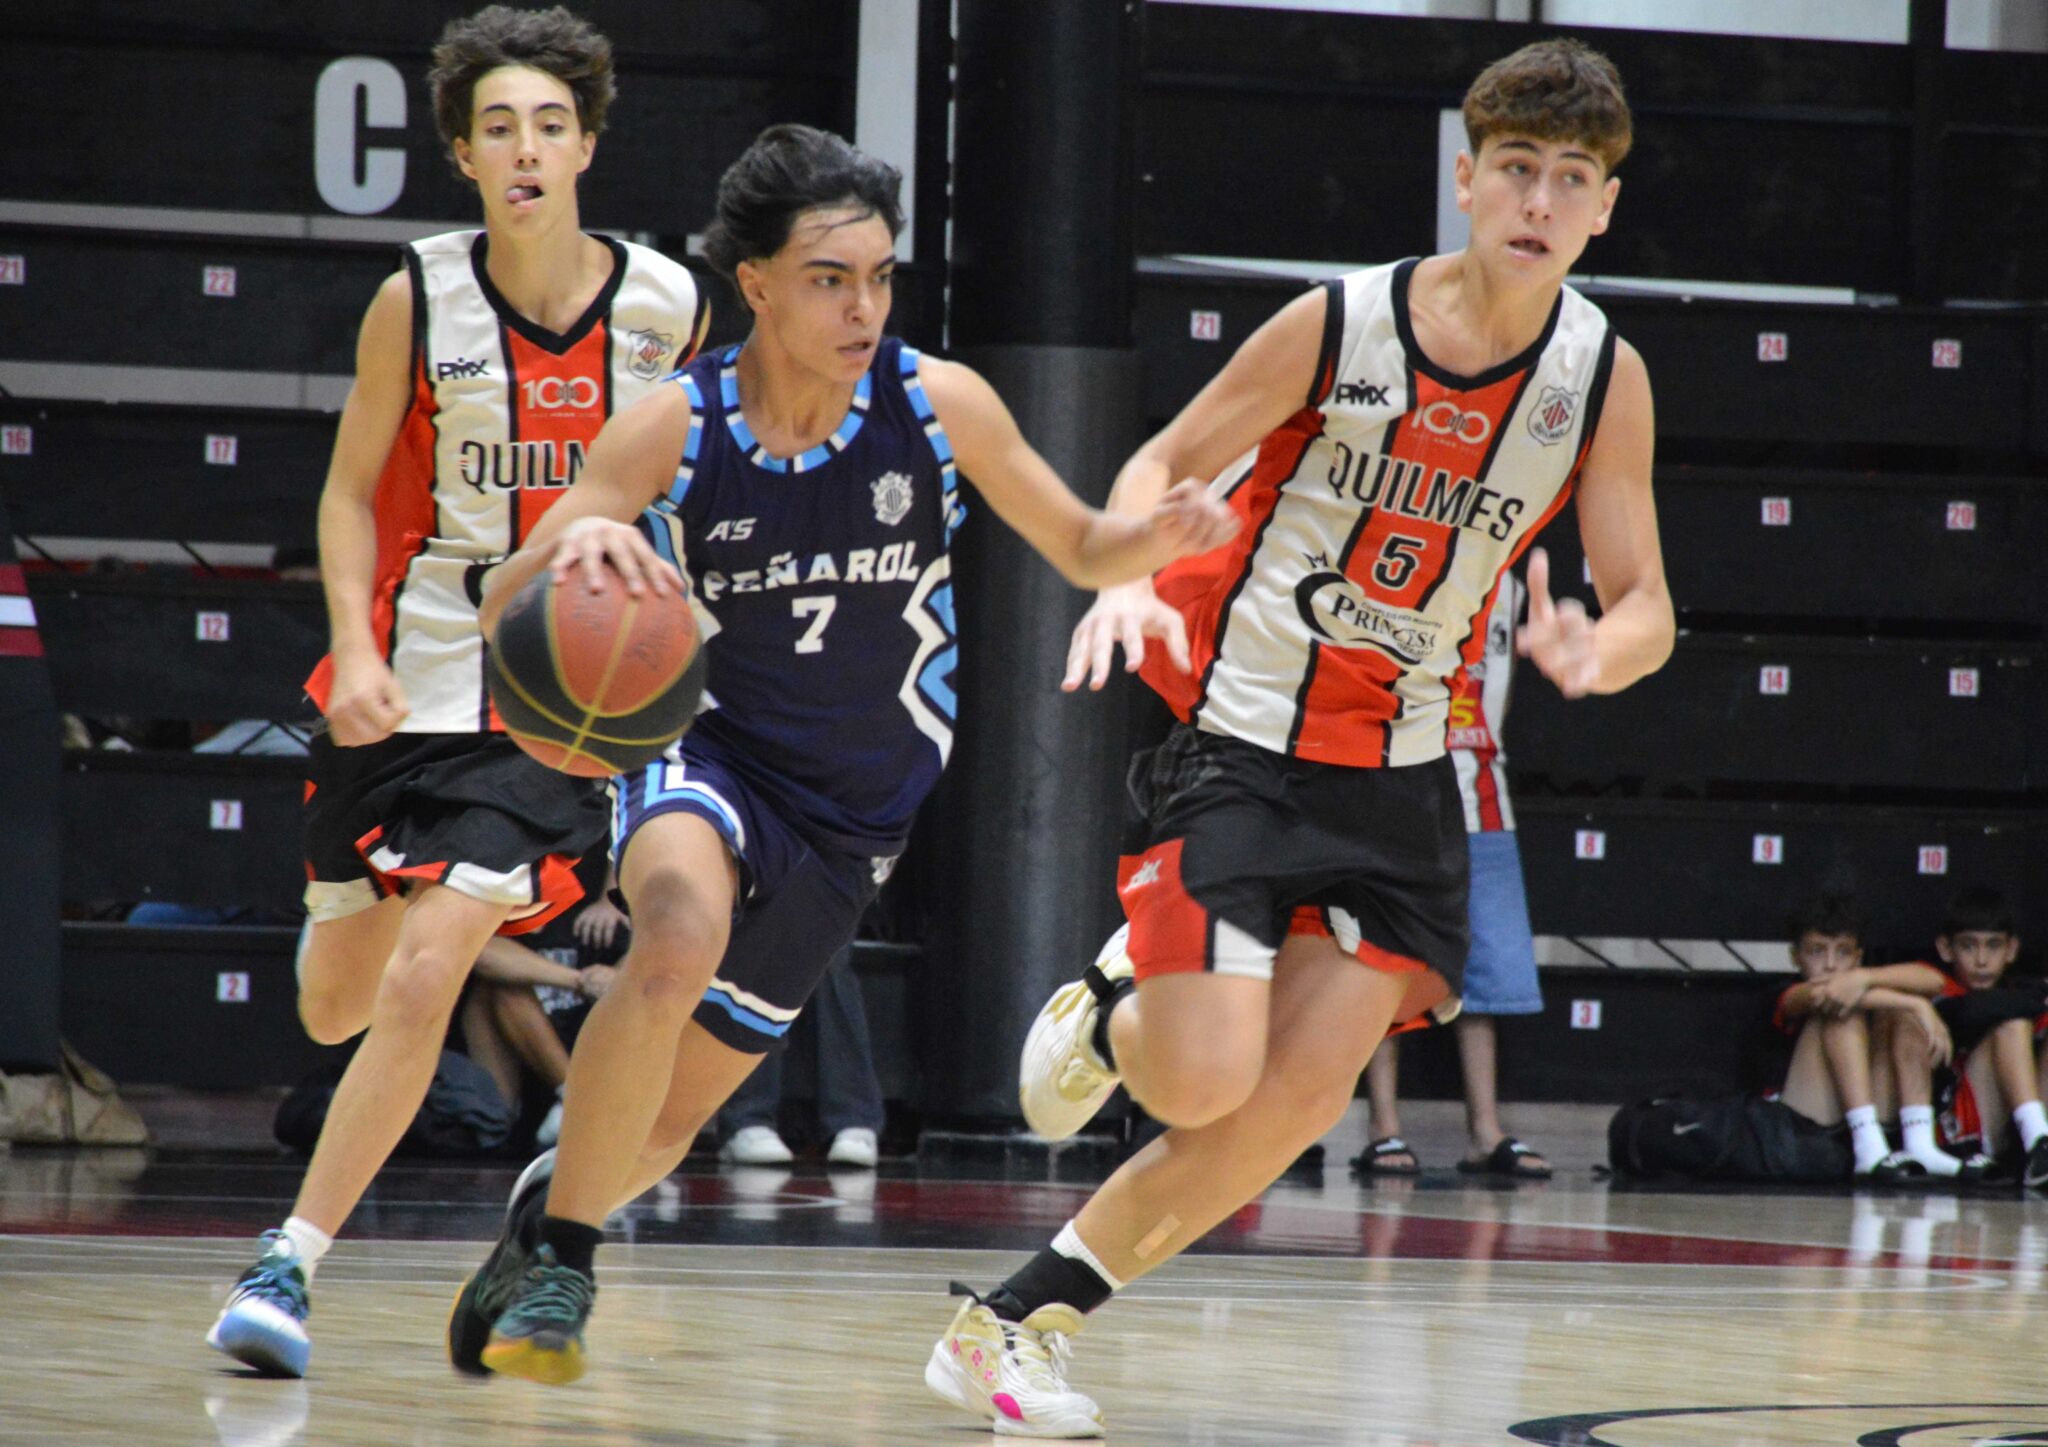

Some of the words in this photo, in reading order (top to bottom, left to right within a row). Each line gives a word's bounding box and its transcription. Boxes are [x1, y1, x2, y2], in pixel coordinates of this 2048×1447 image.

[314, 56, 407, 215] C
[0, 260, 20, 281] 21
[208, 271, 230, 293] 22
[1198, 316, 1216, 337] 21
[1762, 337, 1783, 357] 24
[1935, 345, 1956, 366] 25
[523, 376, 599, 409] 100
[1411, 402, 1491, 444] 100
[6, 431, 27, 451] 16
[213, 440, 231, 461] 17
[459, 440, 586, 495] QUIL
[1328, 441, 1524, 541] QUILMES
[1768, 502, 1786, 523] 19
[1951, 508, 1972, 529] 20
[703, 541, 919, 601] PEÑAROL
[1373, 533, 1427, 590] 5
[204, 617, 224, 639] 12
[791, 595, 837, 654] 7
[1766, 671, 1784, 689] 14
[1956, 673, 1974, 692] 15
[221, 803, 231, 825] 7
[1585, 835, 1595, 855] 8
[1763, 839, 1773, 859] 9
[1925, 850, 1941, 871] 10
[227, 976, 238, 998] 2
[1580, 1004, 1591, 1025] 3
